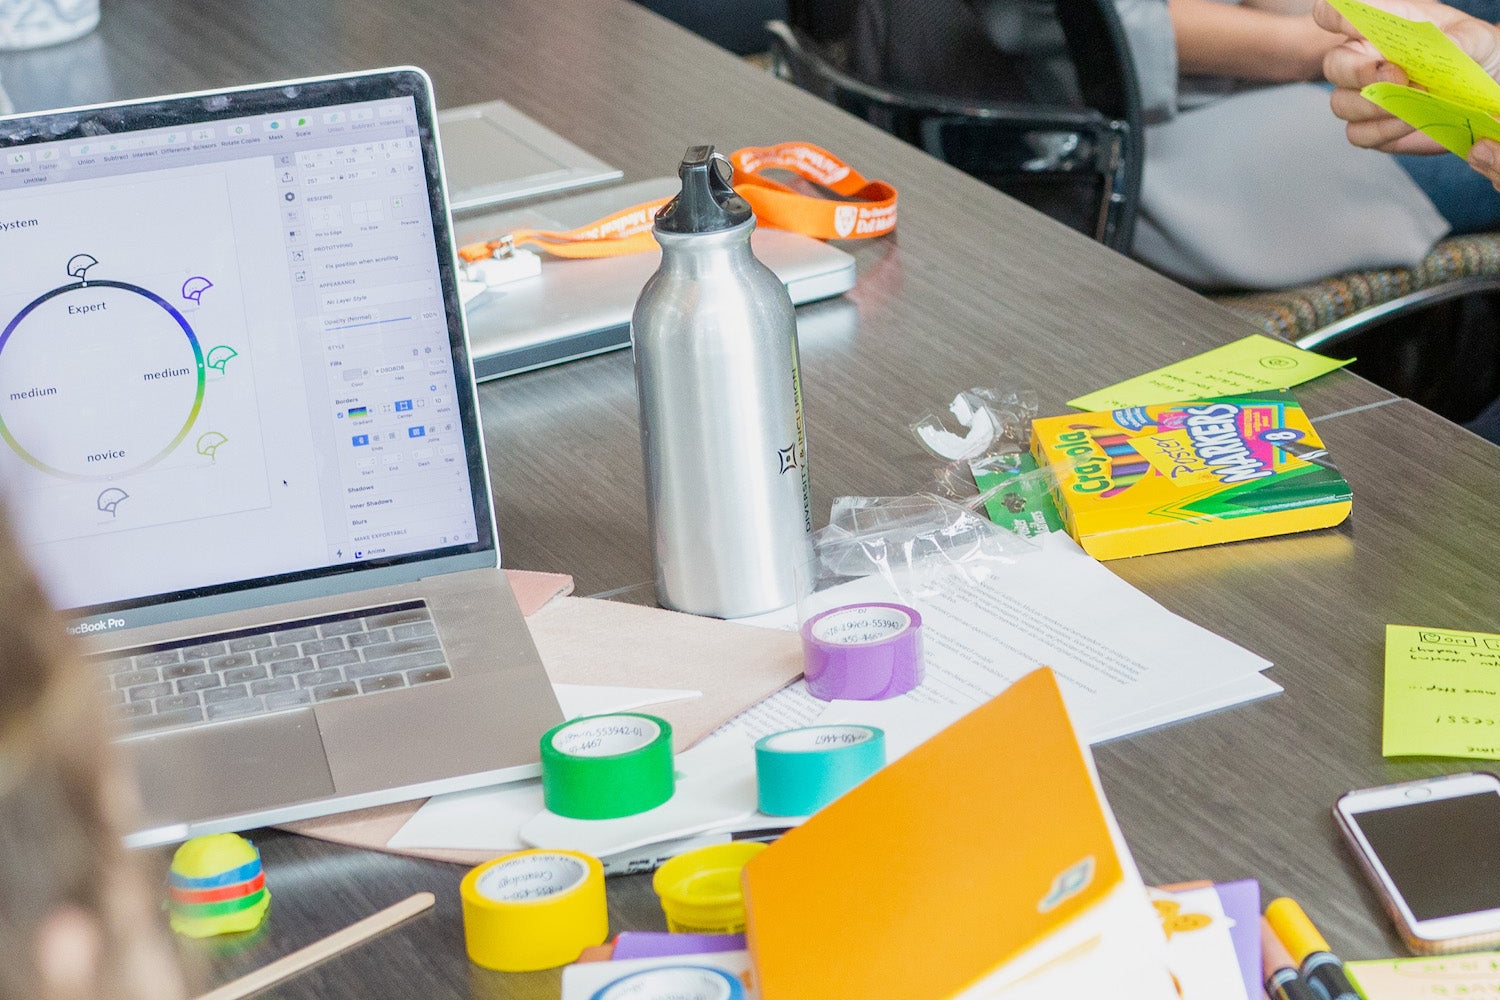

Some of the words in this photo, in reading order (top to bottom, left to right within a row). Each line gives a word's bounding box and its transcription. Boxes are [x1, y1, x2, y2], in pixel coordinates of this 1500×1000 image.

[241, 136, 260, 146] Copies
[160, 146, 191, 155] Difference
[78, 158, 96, 166] Union
[11, 166, 30, 175] Rotate
[24, 176, 47, 184] Untitled
[335, 261, 358, 269] position
[68, 301, 107, 315] Expert
[143, 366, 190, 381] medium
[10, 385, 57, 400] medium
[335, 397, 358, 405] Borders
[791, 368, 804, 446] INCLUSION
[1188, 402, 1276, 484] MARKERS
[87, 449, 126, 463] novice
[1058, 428, 1110, 494] Crayola
[1150, 436, 1208, 478] Poster
[348, 484, 374, 493] Shadows
[366, 499, 393, 507] Shadows
[800, 464, 811, 533] DIVERSITY
[107, 618, 125, 629] Pro
